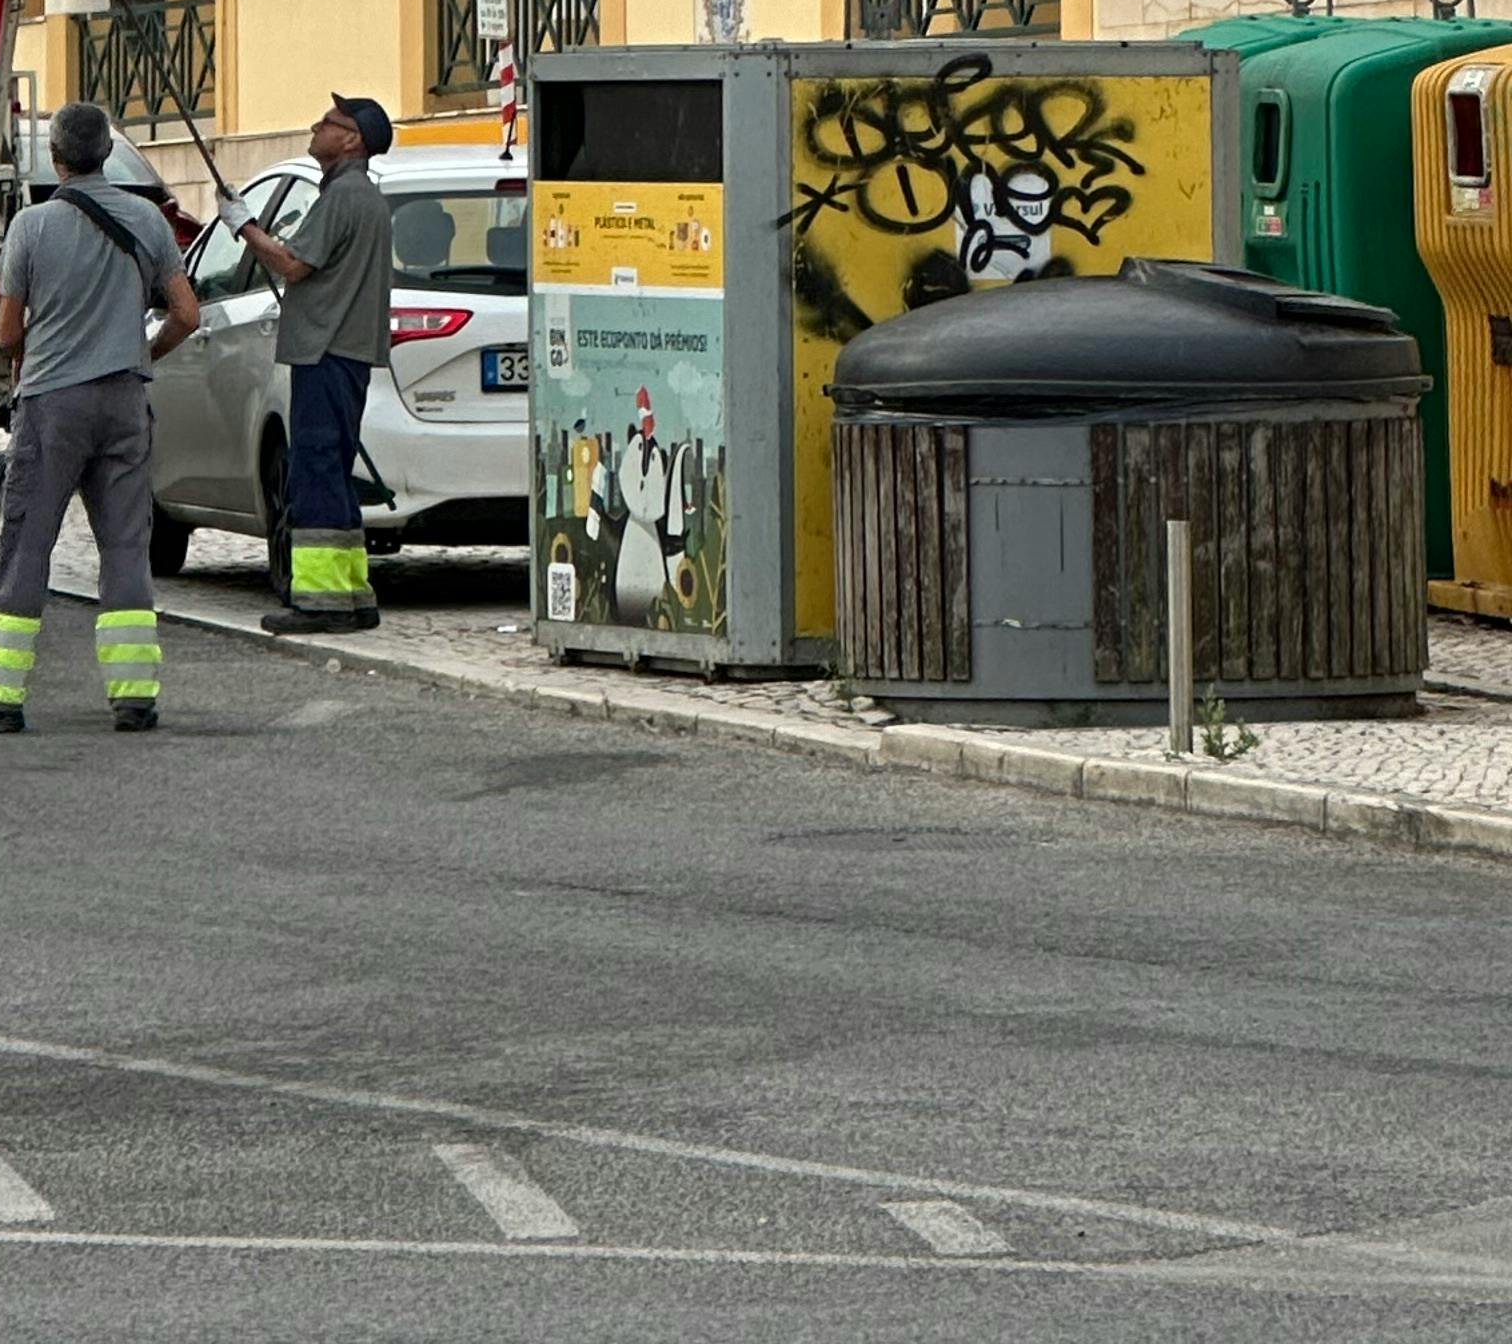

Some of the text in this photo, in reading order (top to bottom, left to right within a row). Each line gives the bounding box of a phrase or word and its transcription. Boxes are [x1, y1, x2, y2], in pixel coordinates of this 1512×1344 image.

[577, 329, 600, 348] ESTE
[600, 329, 648, 350] ECOPONTO
[664, 329, 708, 353] PRÉMIOS!
